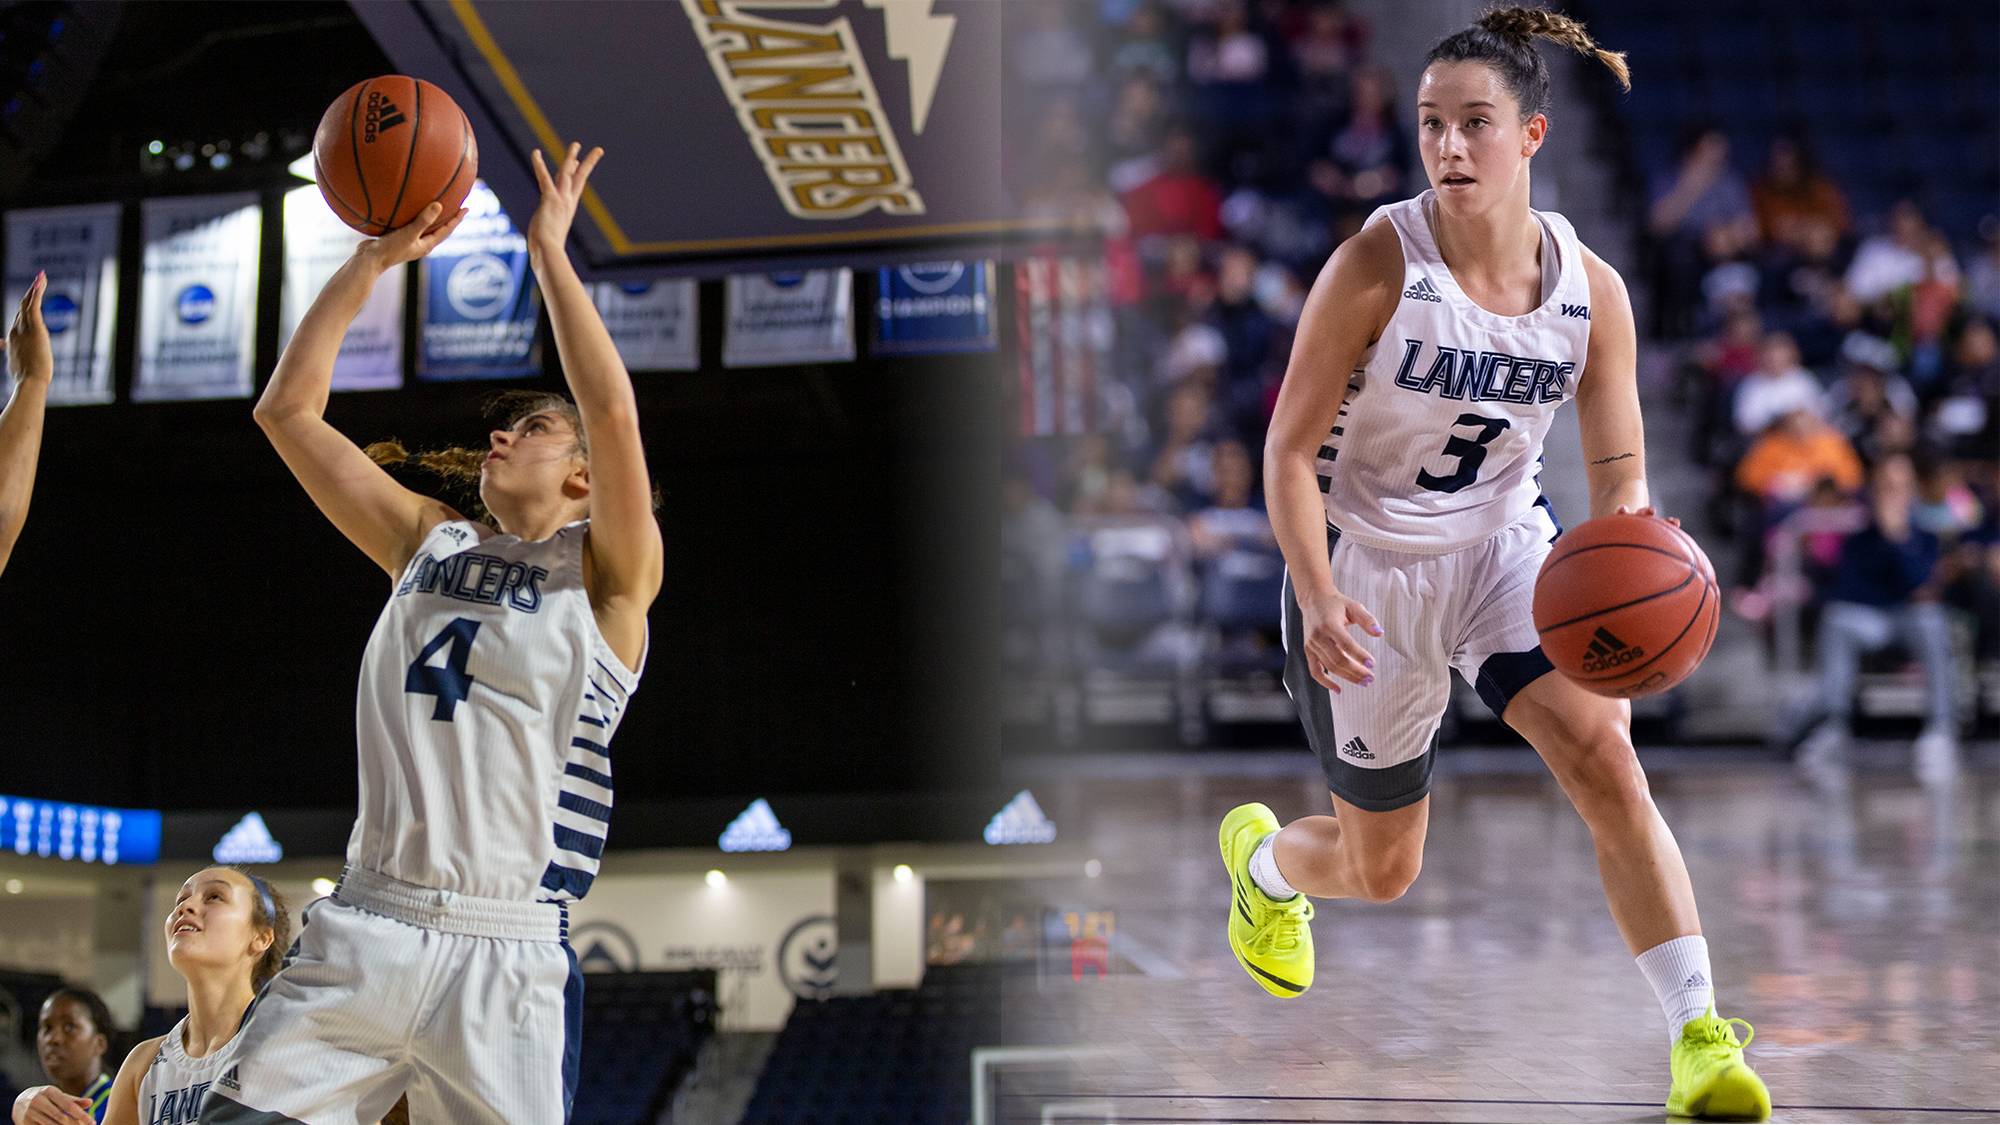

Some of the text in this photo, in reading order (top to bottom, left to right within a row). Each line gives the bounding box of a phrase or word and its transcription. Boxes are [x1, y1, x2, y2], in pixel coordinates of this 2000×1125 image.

[365, 91, 381, 144] adidas
[1403, 289, 1442, 303] adidas
[1559, 303, 1591, 321] WA
[1394, 338, 1576, 405] LANCERS
[1415, 413, 1511, 494] 3
[397, 552, 549, 614] LANCERS
[405, 616, 482, 722] 4
[1582, 645, 1644, 674] adidas
[1342, 746, 1375, 760] adidas
